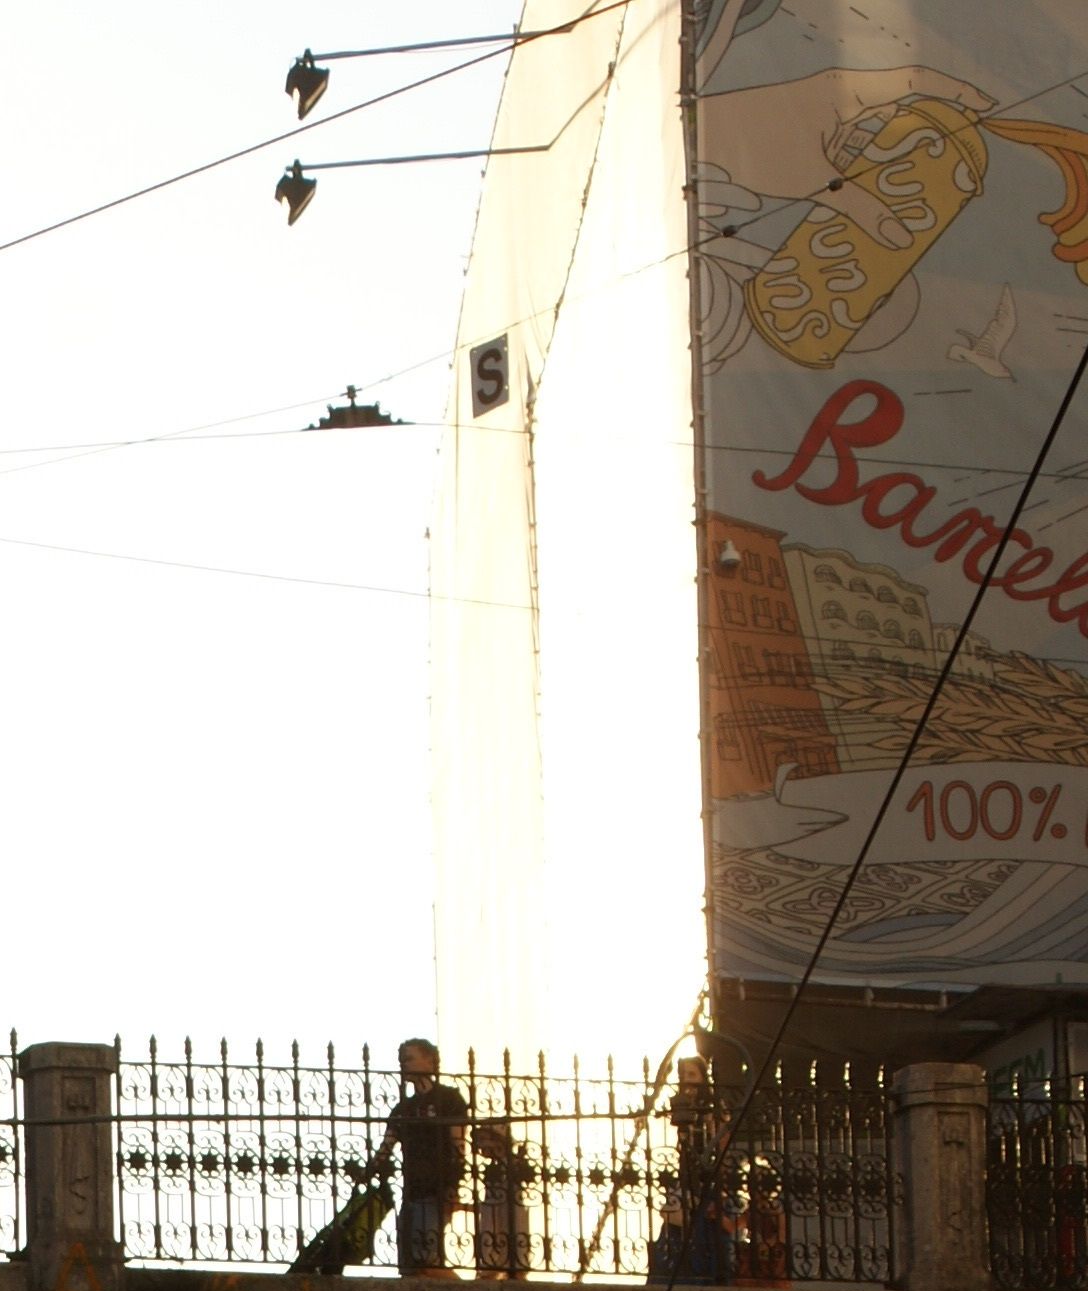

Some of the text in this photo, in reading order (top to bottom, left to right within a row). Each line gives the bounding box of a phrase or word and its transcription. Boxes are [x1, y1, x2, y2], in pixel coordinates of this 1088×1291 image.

[477, 347, 505, 406] S
[751, 379, 1088, 638] Barcel
[906, 780, 1068, 842] 100%
